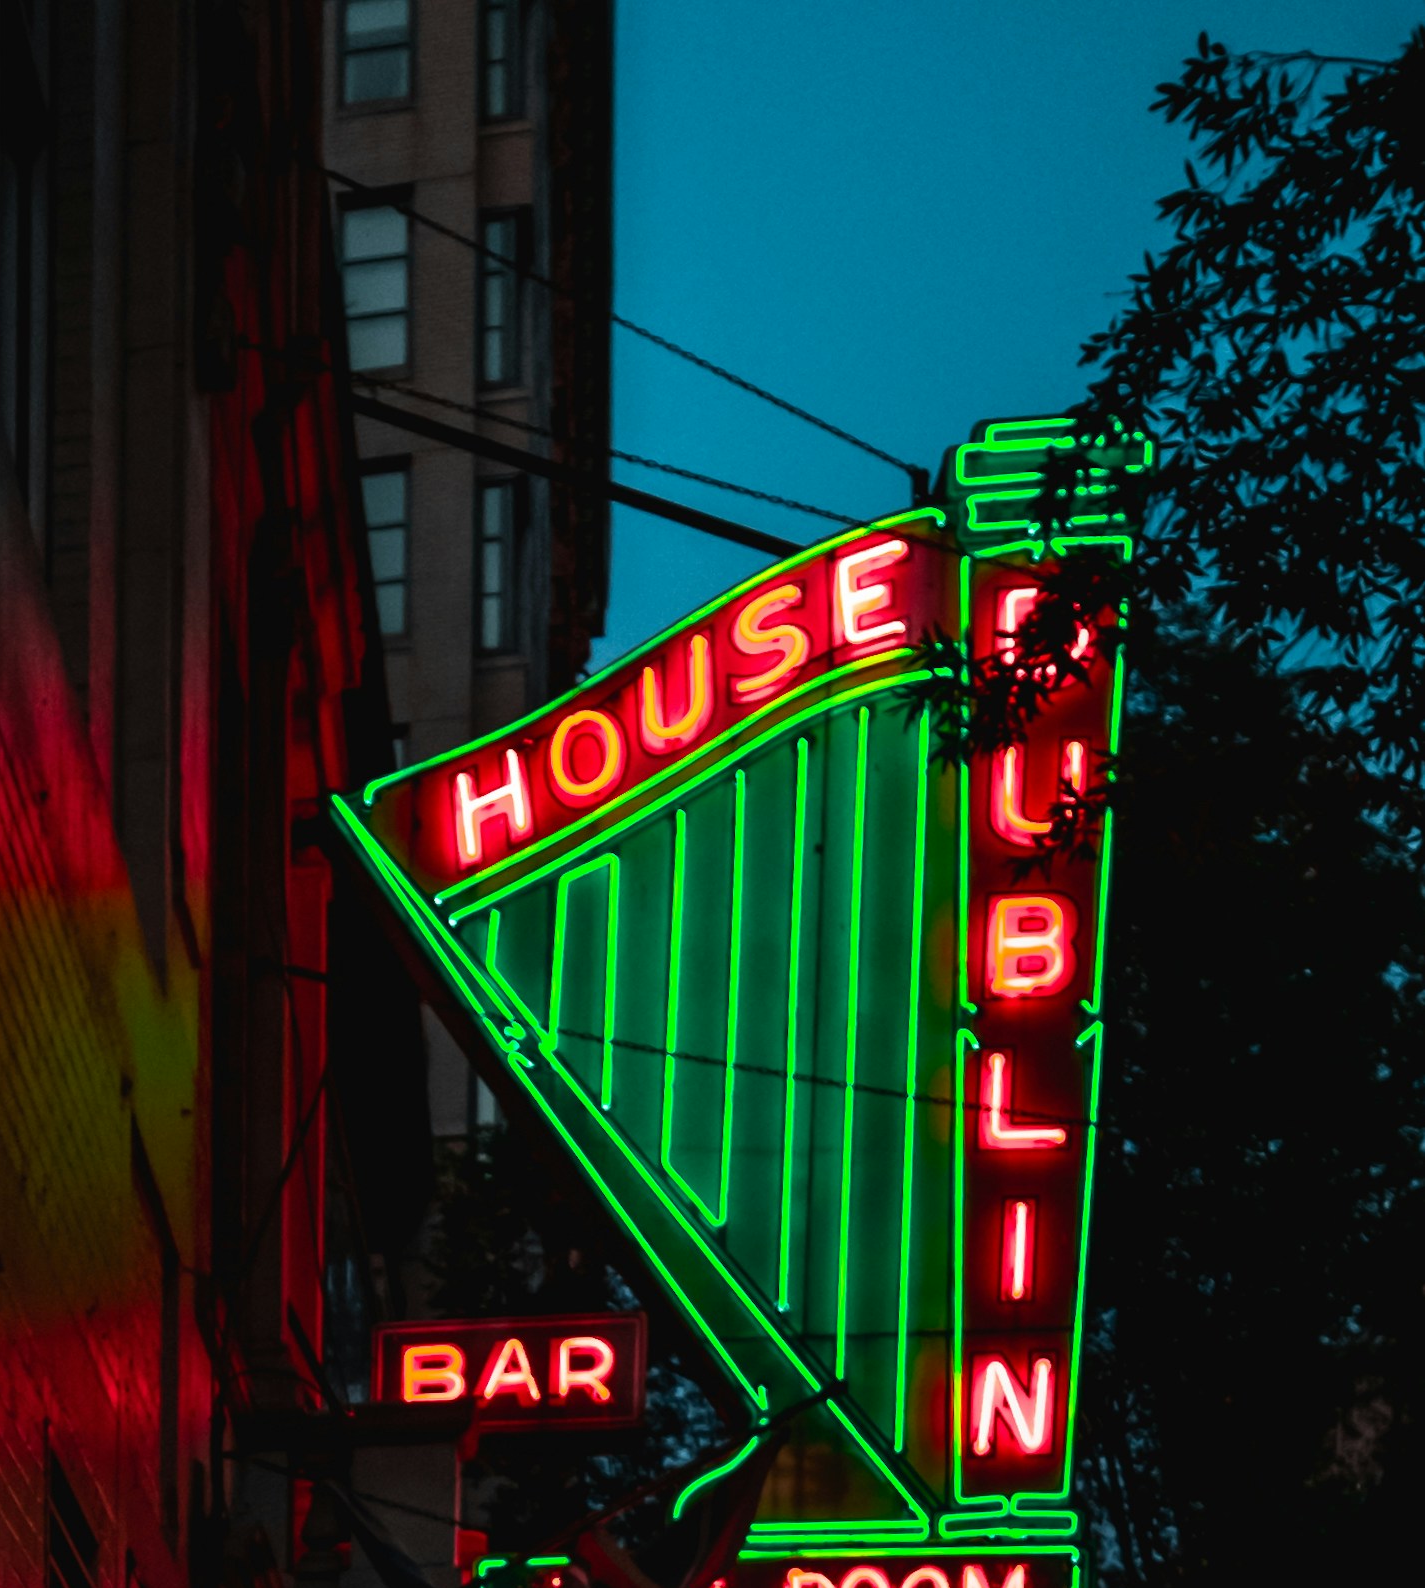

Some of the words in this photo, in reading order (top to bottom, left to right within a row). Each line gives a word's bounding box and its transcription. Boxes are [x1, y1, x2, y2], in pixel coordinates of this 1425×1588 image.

[454, 537, 911, 868] HOUSE
[971, 586, 1091, 1456] DUBLIN
[401, 1334, 617, 1404] BAR
